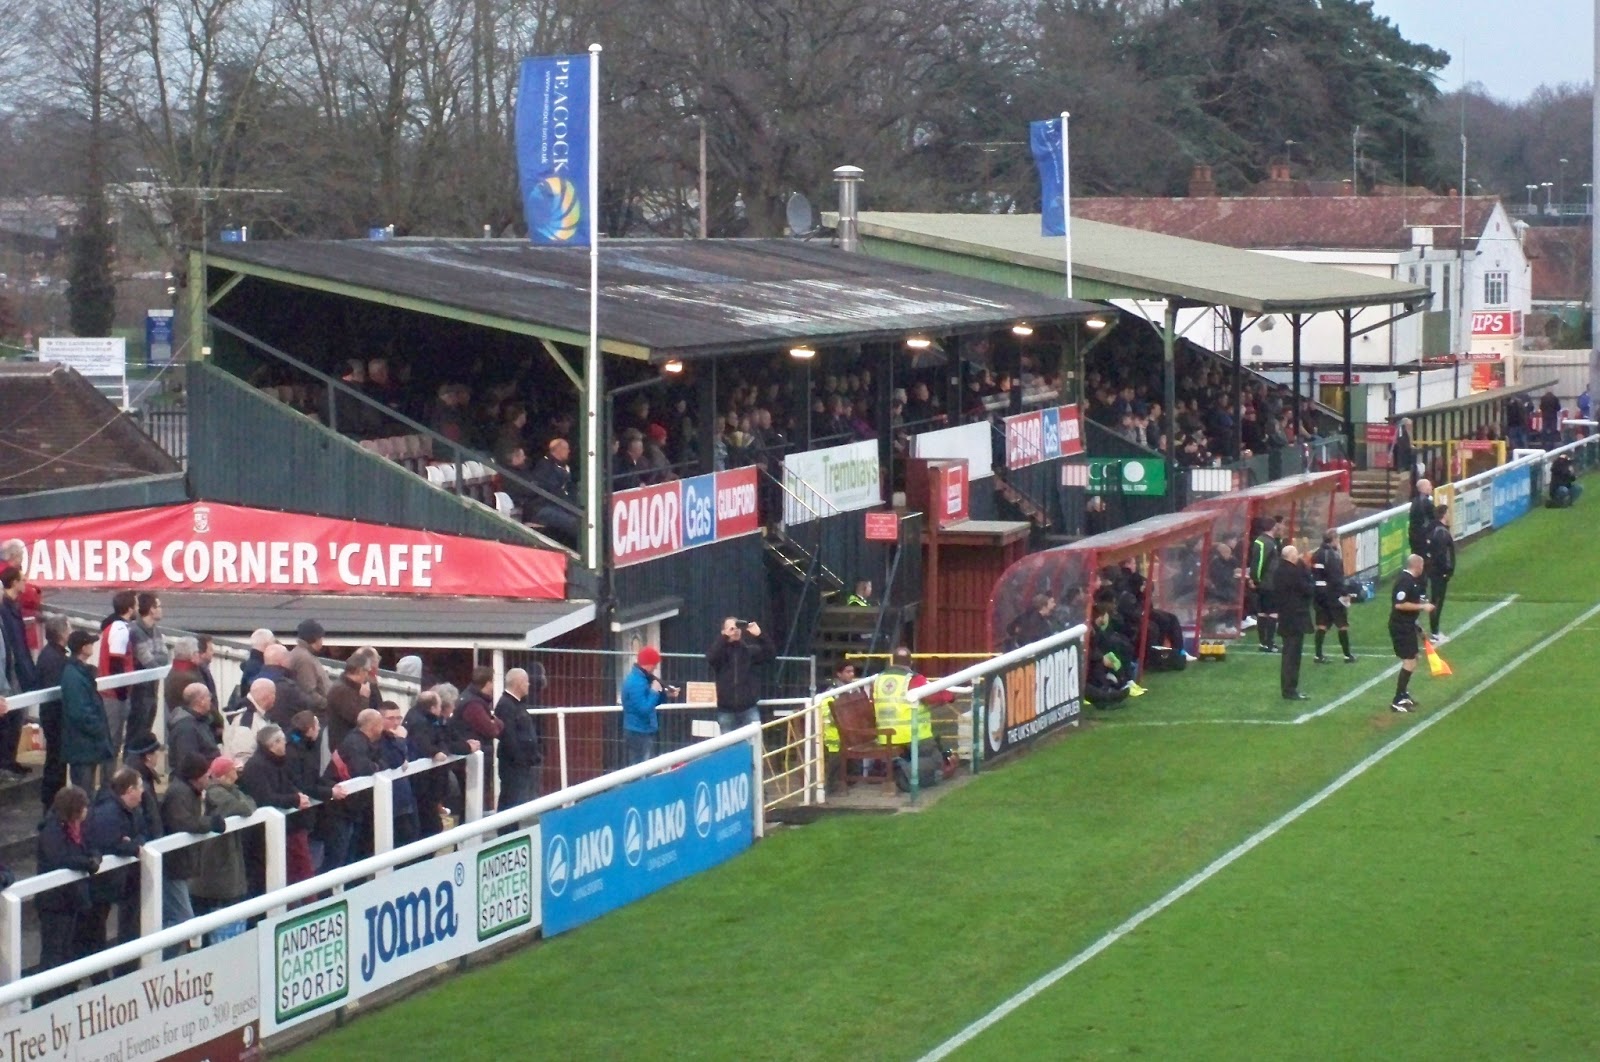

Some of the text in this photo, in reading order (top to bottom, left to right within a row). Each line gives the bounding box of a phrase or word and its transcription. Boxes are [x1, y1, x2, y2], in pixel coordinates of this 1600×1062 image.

[552, 60, 570, 173] PEACOCK
[612, 491, 678, 556] CALOR
[685, 484, 711, 540] Gas
[162, 540, 319, 584] CORNER
[714, 772, 749, 822] JAKO
[646, 799, 686, 850] JAKO
[481, 846, 528, 879] ANDREAS
[573, 825, 614, 880] JAKO
[481, 870, 528, 906] CARTER
[481, 893, 529, 930] SPORTS
[281, 914, 343, 955] ANDREAS
[281, 939, 344, 983] CARTER
[281, 964, 345, 1010] SPORTS
[4, 1027, 46, 1062] Tree
[50, 1013, 72, 1059] by
[77, 994, 139, 1040] Hilton
[141, 968, 215, 1013] Woking
[126, 1033, 161, 1060] Events
[163, 1021, 179, 1046] for
[181, 1020, 196, 1044] up
[198, 1015, 210, 1032] to
